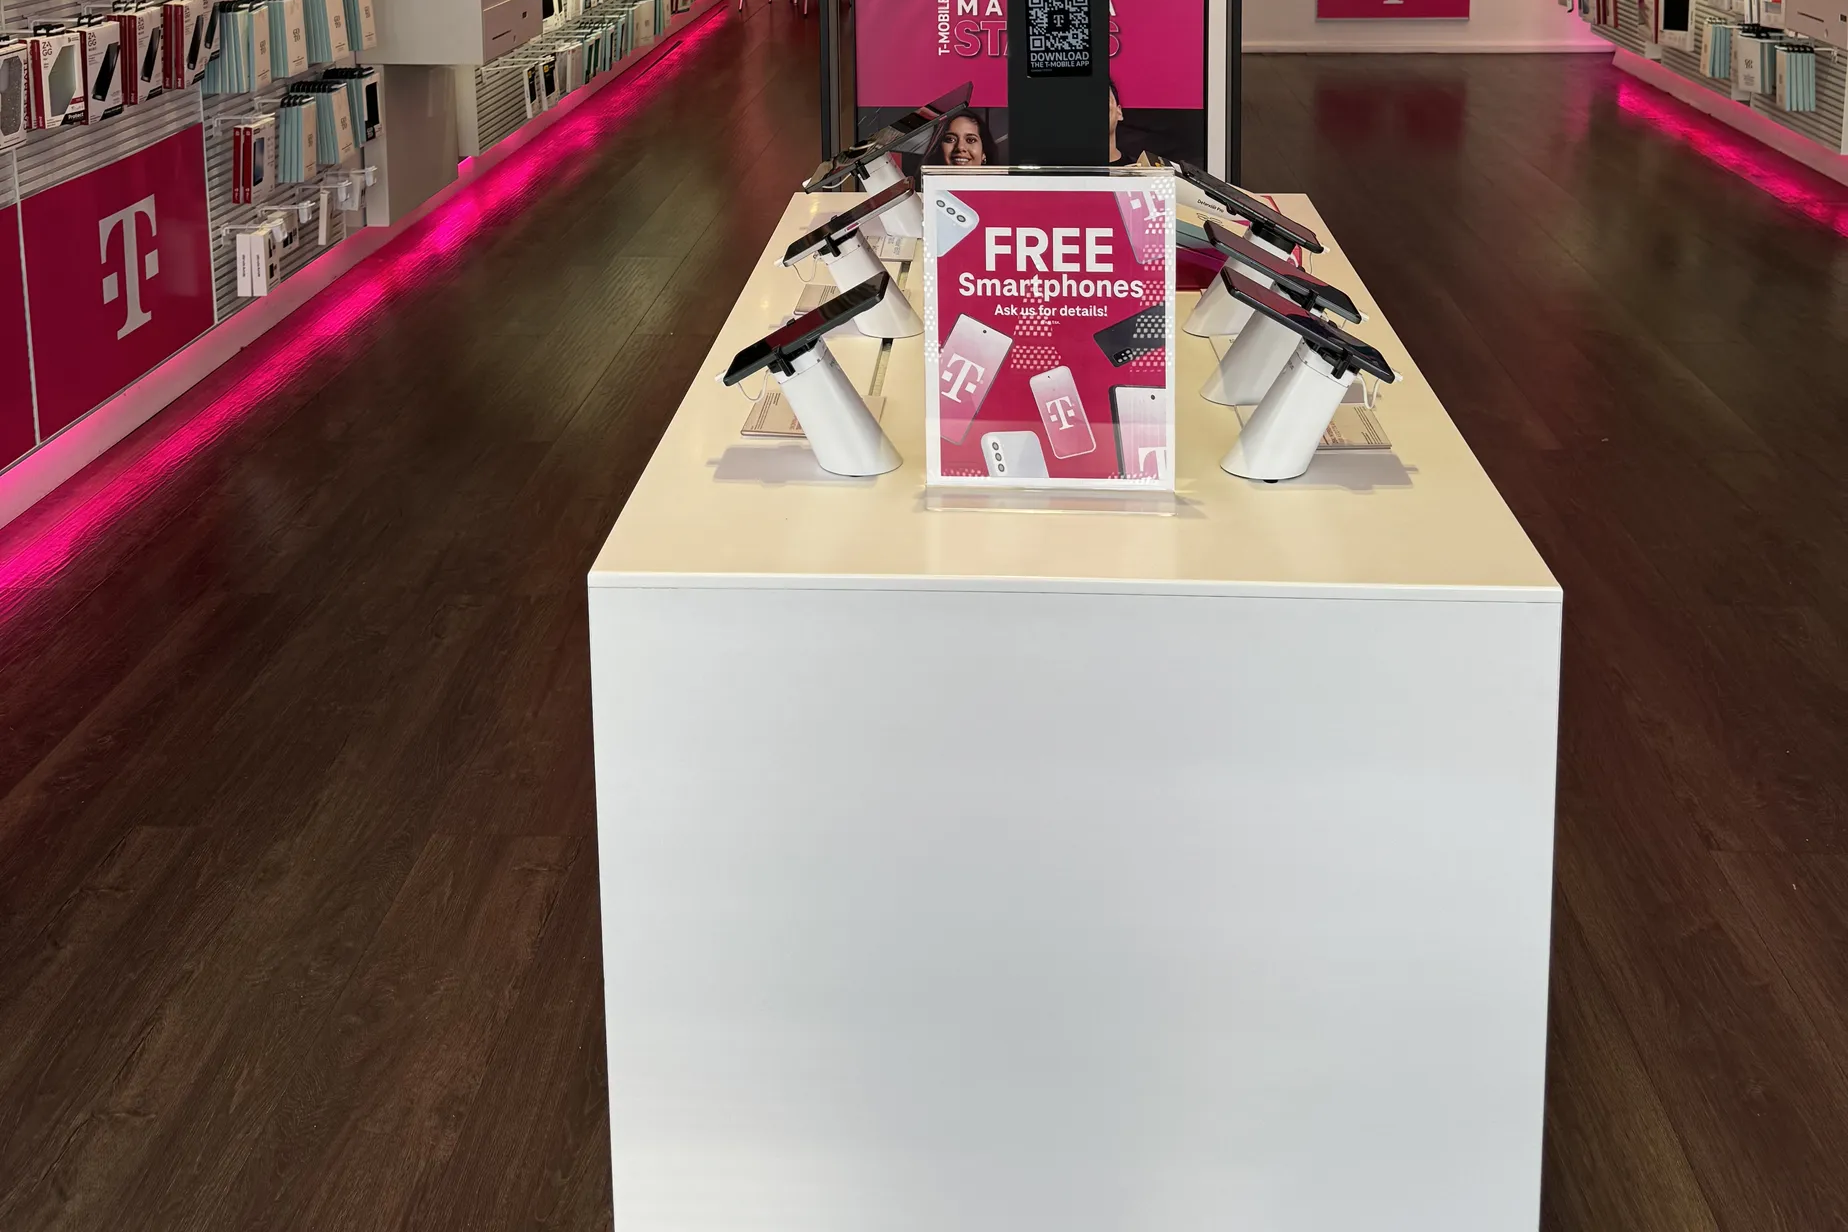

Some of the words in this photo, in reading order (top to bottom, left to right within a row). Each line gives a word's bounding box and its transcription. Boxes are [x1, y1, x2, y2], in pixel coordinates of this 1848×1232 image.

[1031, 52, 1089, 61] DOWNLOAD
[985, 227, 1114, 272] FREE
[958, 272, 1144, 301] Smartphones
[994, 305, 1018, 316] Ask
[1020, 307, 1036, 316] us
[1038, 304, 1057, 316] for
[1059, 305, 1108, 317] details!
